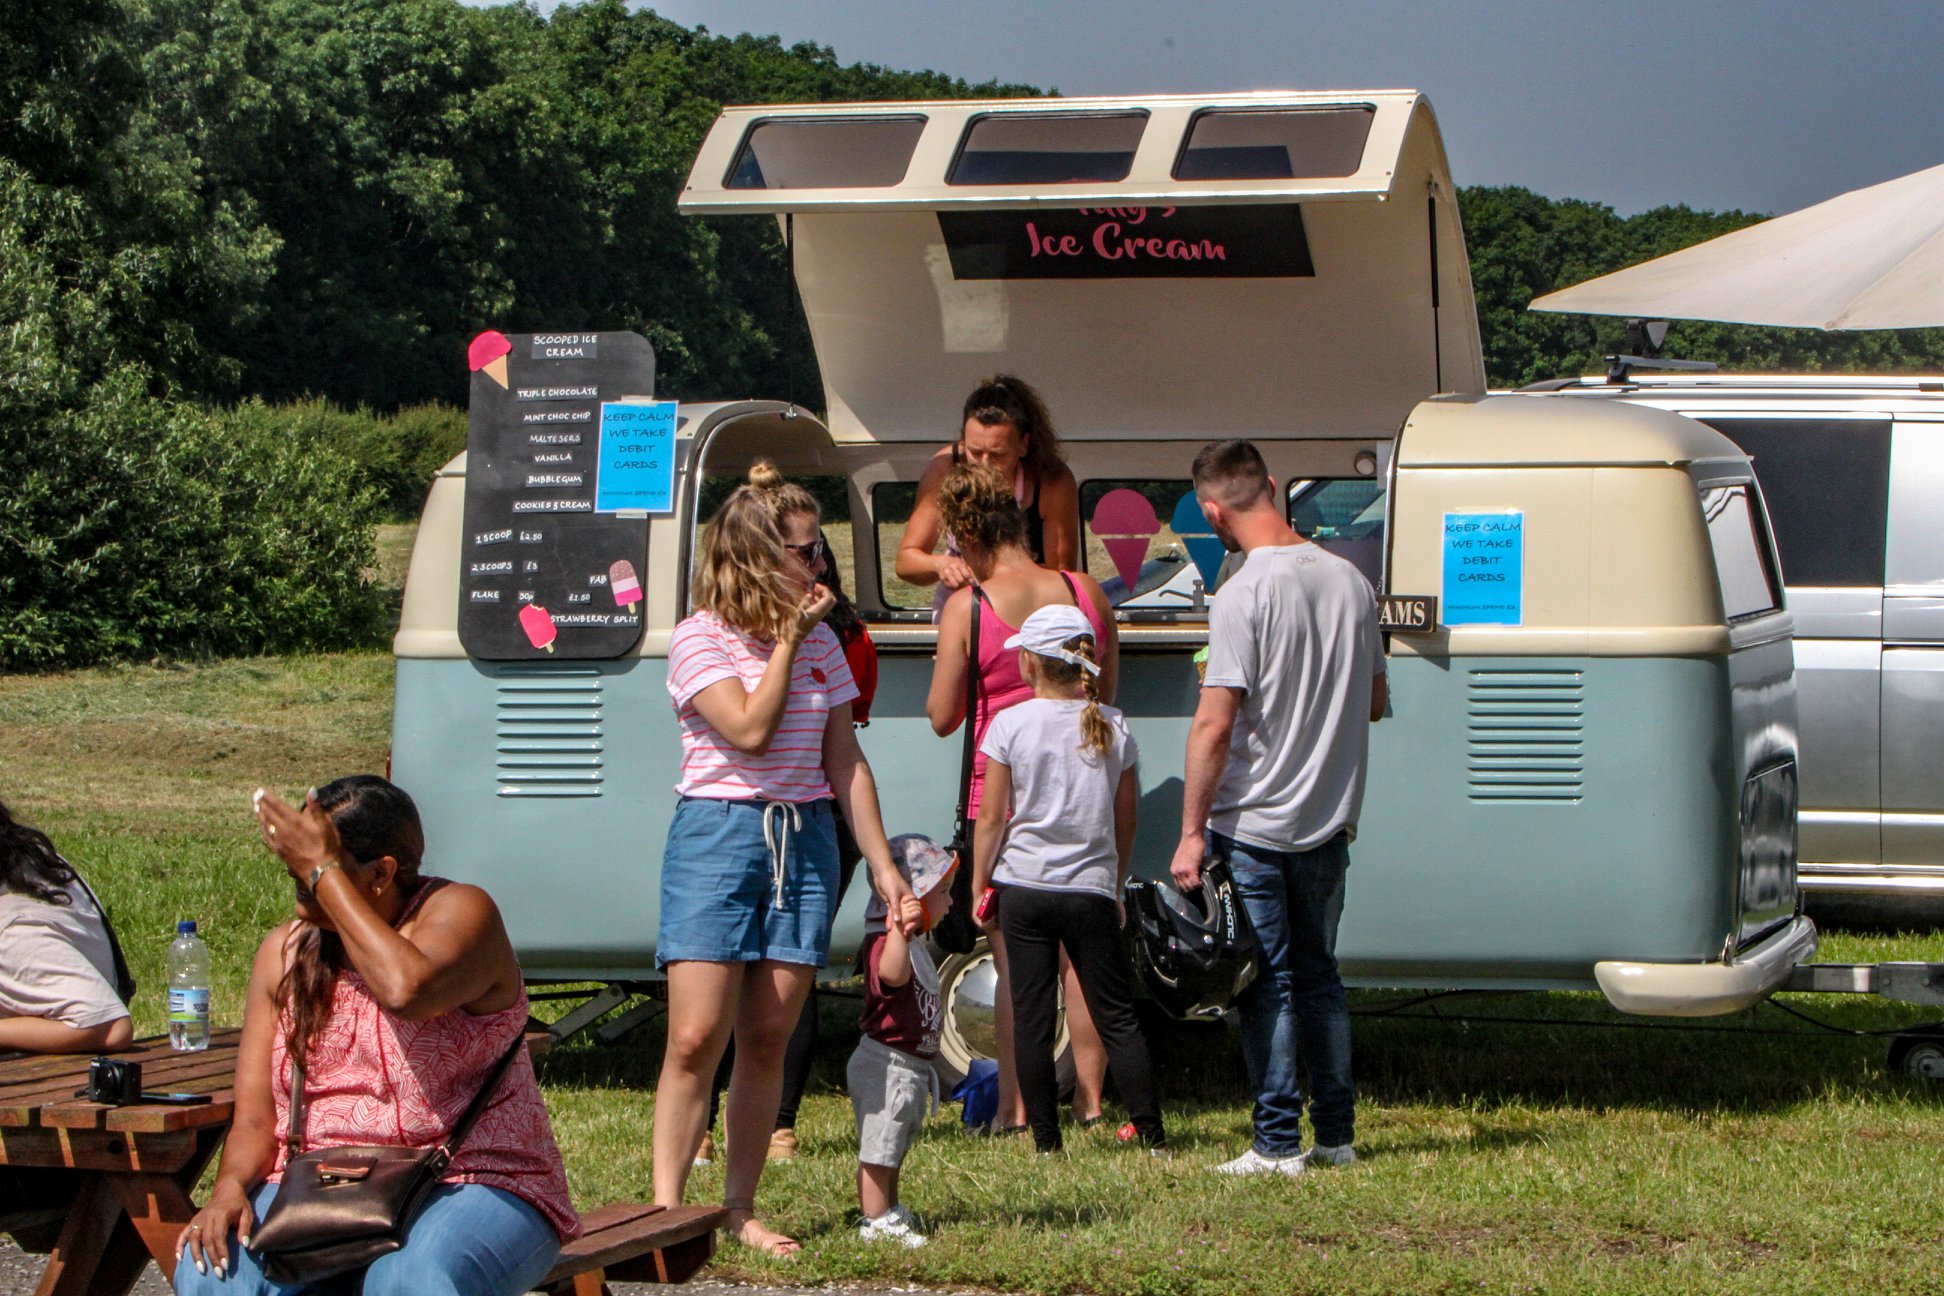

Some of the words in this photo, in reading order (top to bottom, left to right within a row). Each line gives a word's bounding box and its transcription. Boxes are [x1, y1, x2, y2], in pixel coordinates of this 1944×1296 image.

[1026, 222, 1083, 257] Ice
[1092, 222, 1226, 261] Cream
[533, 335, 579, 345] SCOOPED
[582, 334, 597, 344] ICE
[546, 347, 584, 357] CREAM
[517, 389, 546, 398] TRIPLE
[548, 387, 597, 397] CHOCOLATE
[524, 413, 546, 422] MINT
[547, 413, 570, 421] CHOC
[571, 411, 591, 420] CHIP
[603, 413, 636, 422] KEEP
[638, 413, 674, 421] CALM
[609, 429, 630, 438] WE
[632, 429, 667, 438] TAKE
[529, 434, 581, 443] MALTESERS
[618, 445, 656, 453] DEBIT
[534, 453, 573, 462] VANILLA
[613, 461, 658, 470] CARDS
[514, 501, 552, 510] COOKIES
[560, 501, 591, 509] CREAM
[1445, 523, 1480, 532] KEEP
[1483, 523, 1521, 532] CALM
[483, 529, 512, 542] SCOOP
[1452, 540, 1473, 549] WE
[1477, 540, 1513, 549] TAKE
[1463, 556, 1502, 565] DEBIT
[471, 564, 479, 572] 2
[480, 561, 513, 571] SCOOPS
[589, 575, 607, 584] FAB
[1458, 573, 1506, 582] CARDS
[472, 590, 500, 599] FLAKE
[1376, 600, 1426, 626] AMS
[550, 615, 610, 624] STRAWBERRY
[613, 615, 639, 623] SPLIT
